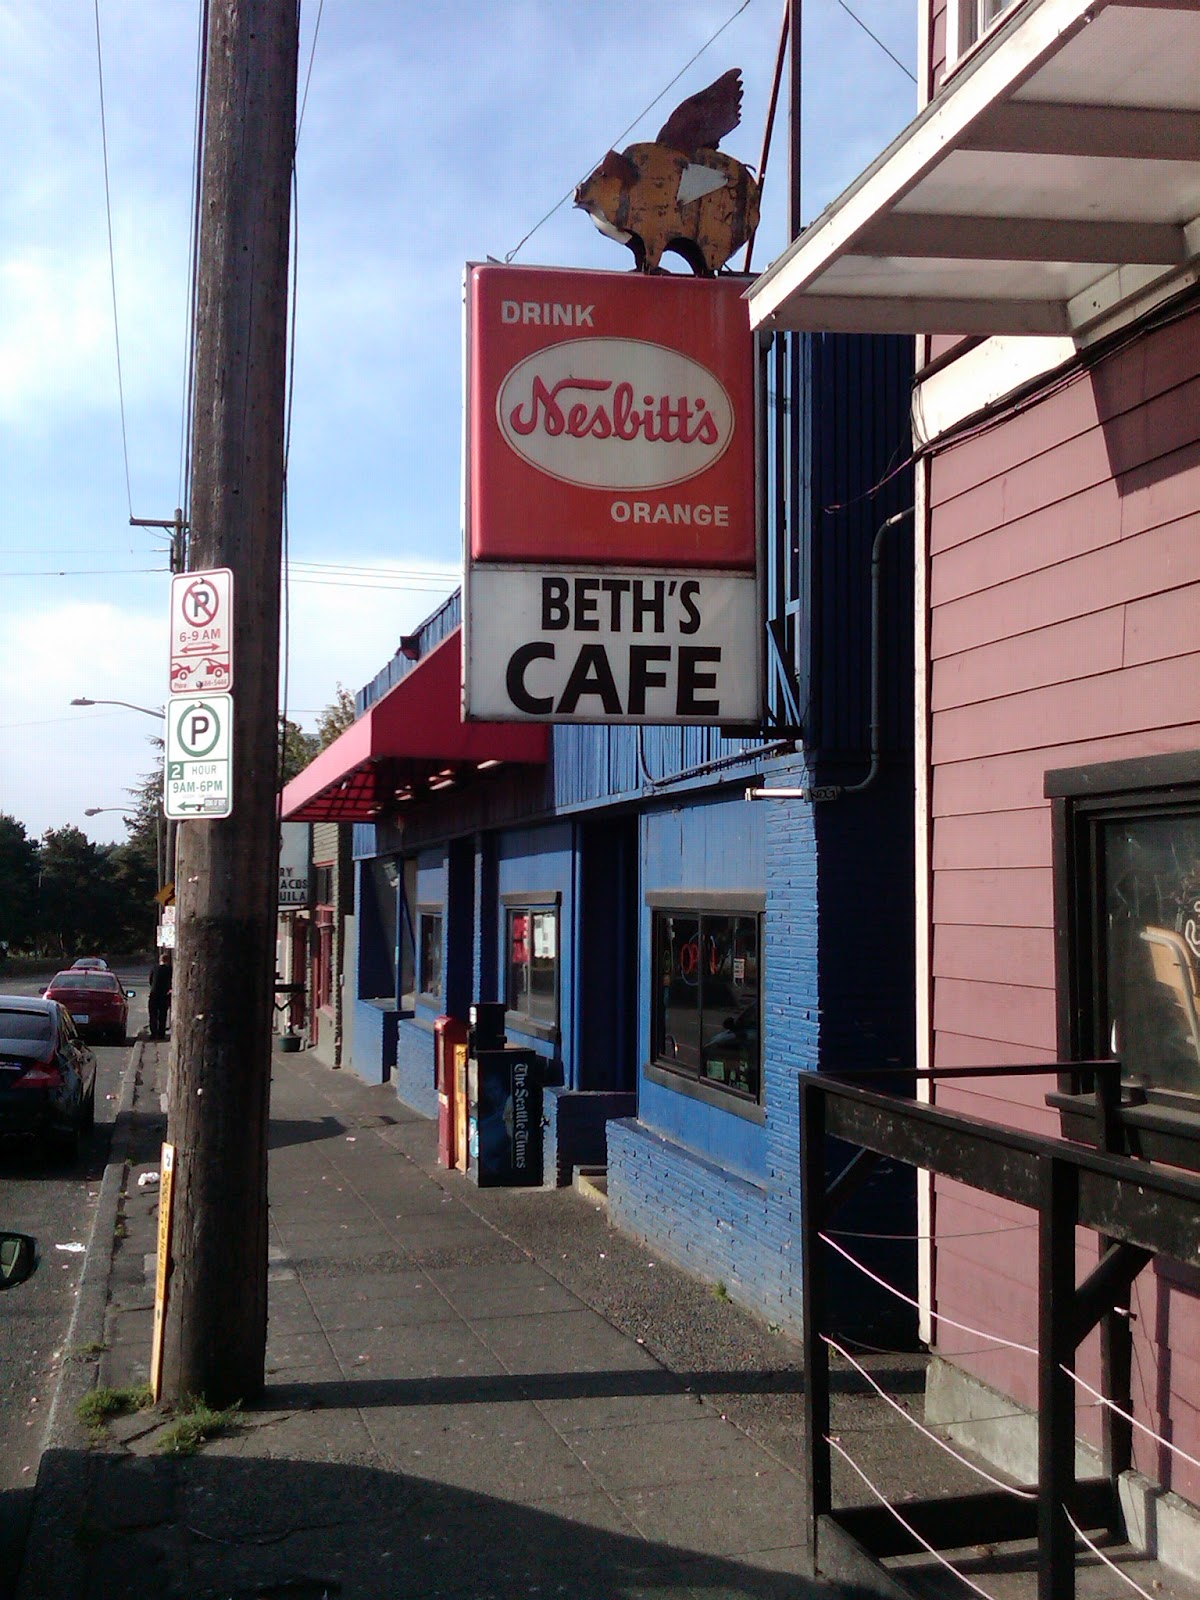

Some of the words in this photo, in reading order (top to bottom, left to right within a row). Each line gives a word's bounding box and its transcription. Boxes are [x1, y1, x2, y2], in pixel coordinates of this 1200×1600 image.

[501, 300, 595, 327] DRINK
[510, 375, 719, 445] Nesbitt's
[610, 501, 729, 527] ORANGE
[541, 577, 701, 634] BETH'S
[179, 630, 199, 643] 6-9
[202, 627, 221, 640] AM
[506, 641, 722, 716] CAFE
[191, 716, 209, 745] P
[171, 764, 181, 779] 2
[191, 764, 217, 776] HOUR
[172, 780, 223, 794] 9AM-6PM
[513, 1063, 529, 1087] The
[514, 1088, 529, 1129] Seattle
[514, 1130, 529, 1169] Times
